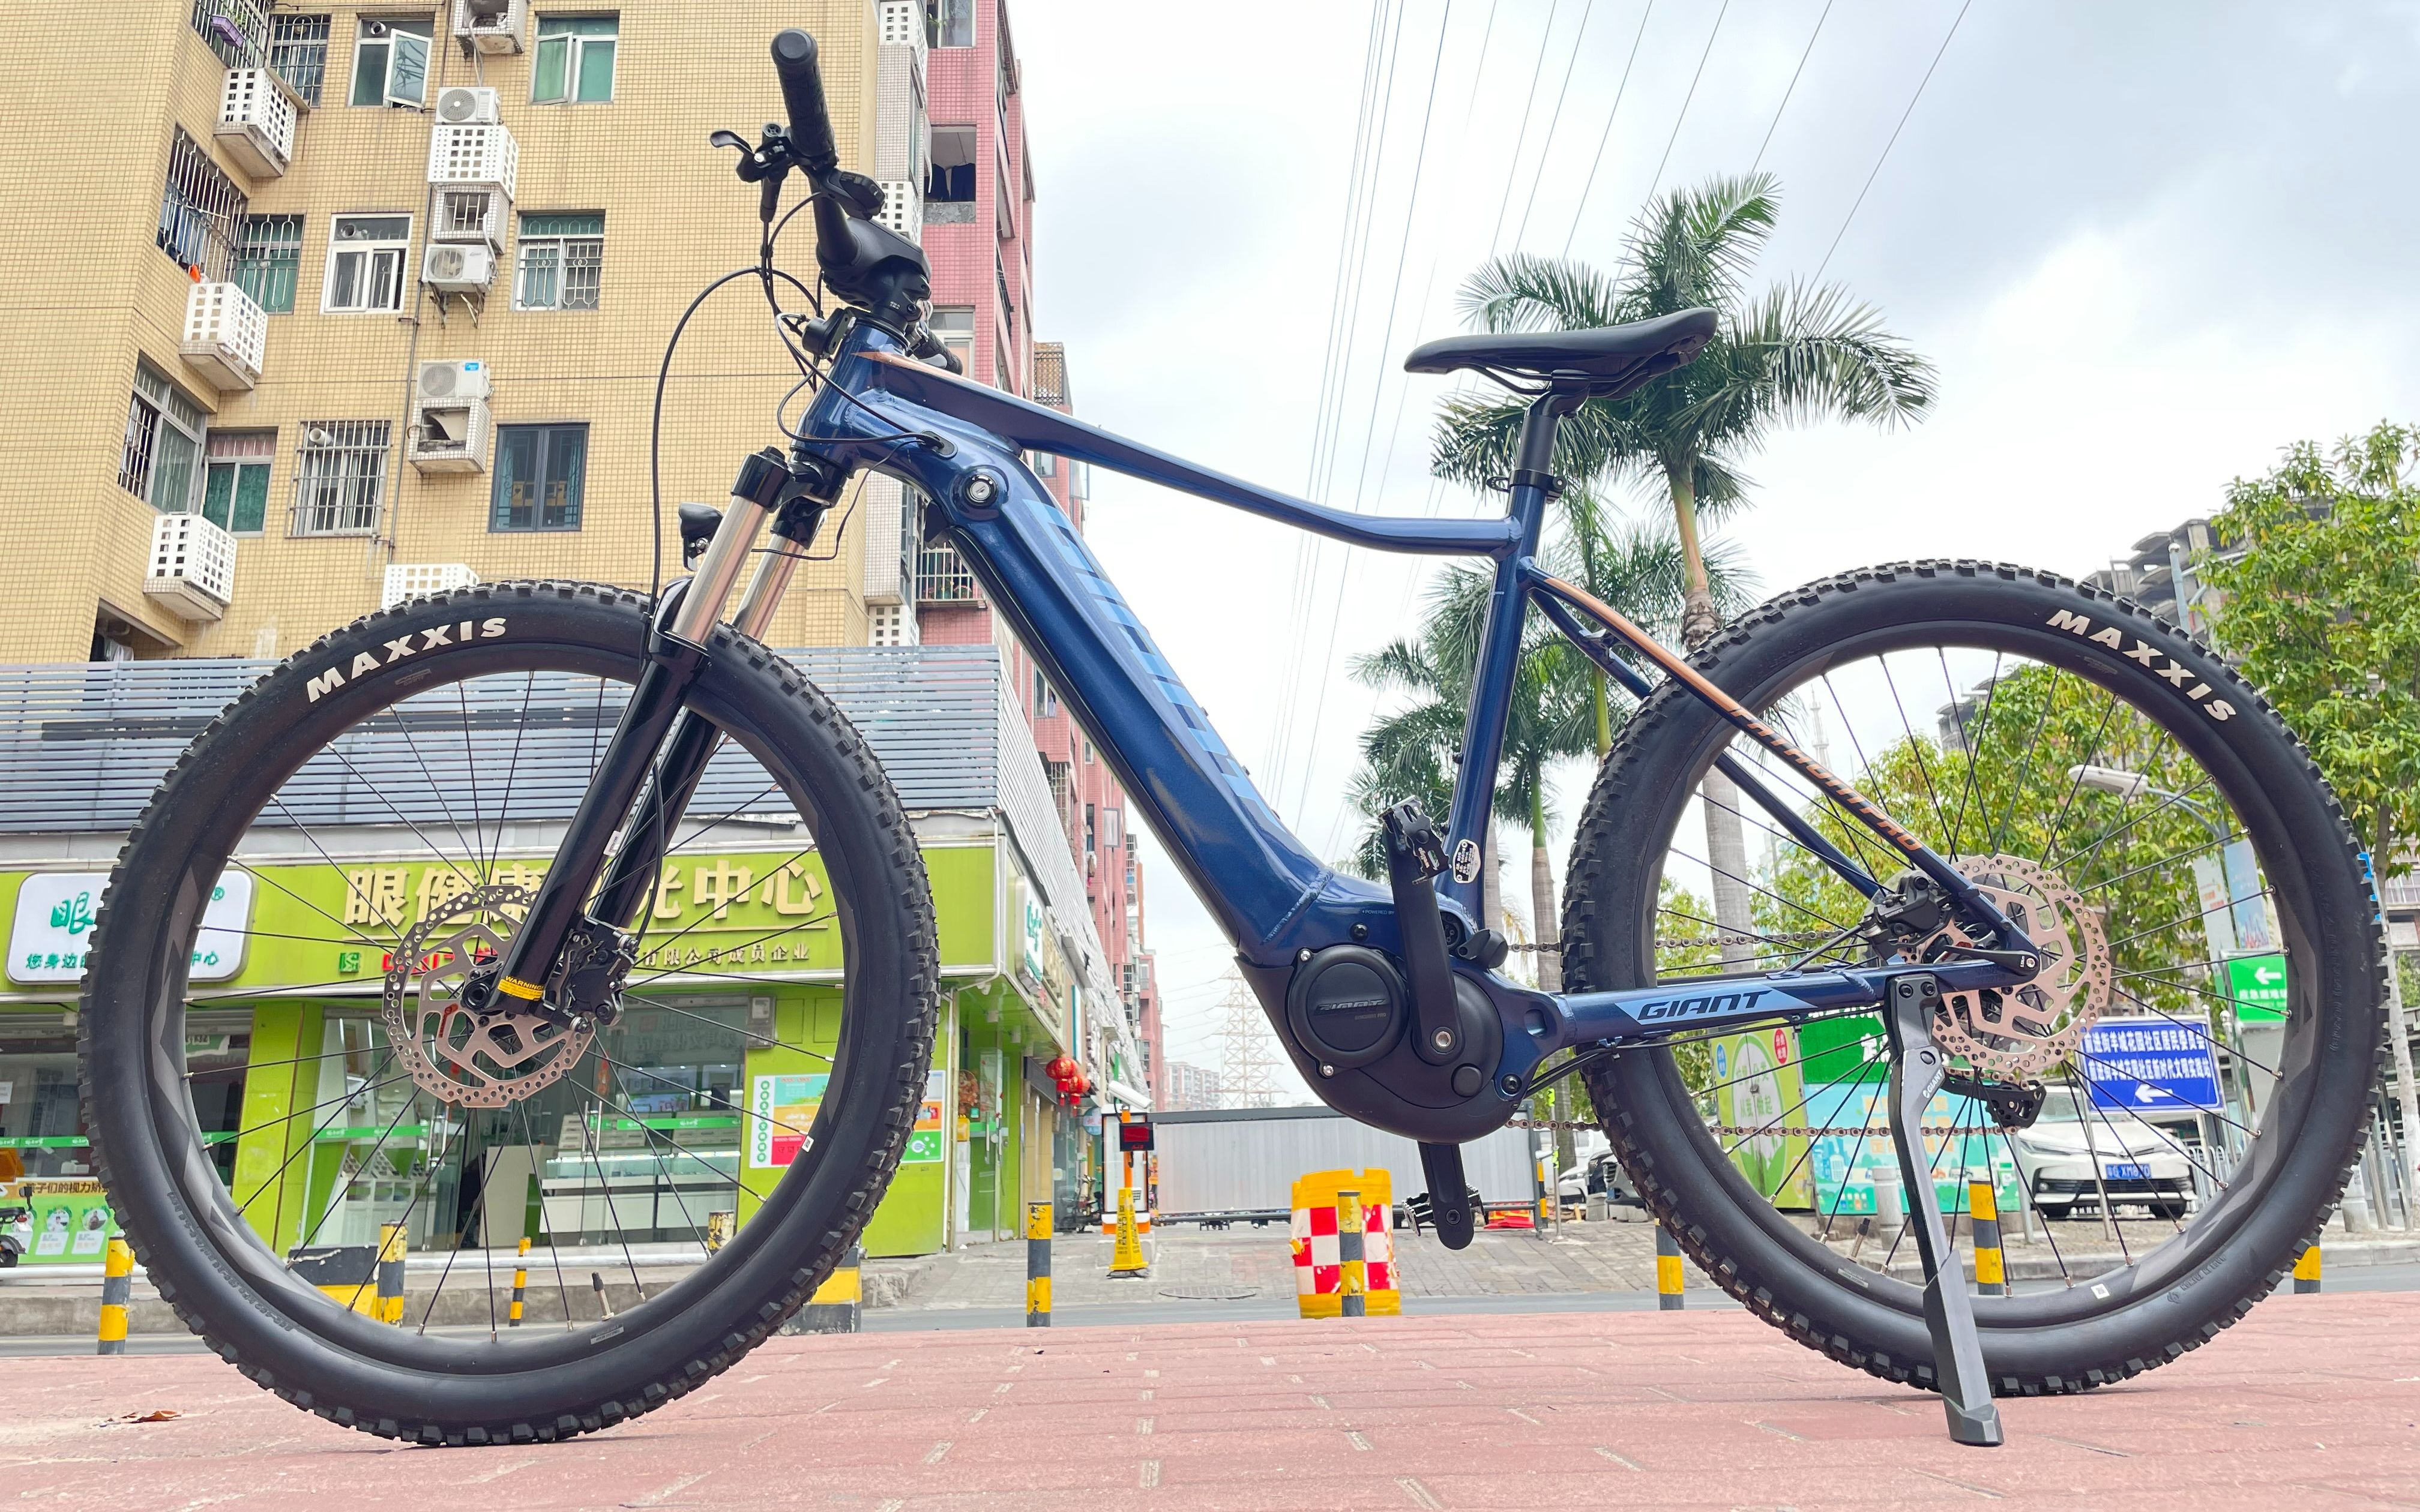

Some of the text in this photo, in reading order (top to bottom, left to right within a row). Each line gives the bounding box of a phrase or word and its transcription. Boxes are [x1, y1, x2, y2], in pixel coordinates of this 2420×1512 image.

[306, 617, 507, 703] MAXXIS
[2045, 609, 2237, 721] MAXXIS
[1859, 806, 1923, 851] PRO
[1637, 990, 1774, 1021] GIANT
[1927, 1069, 1942, 1093] GIANT
